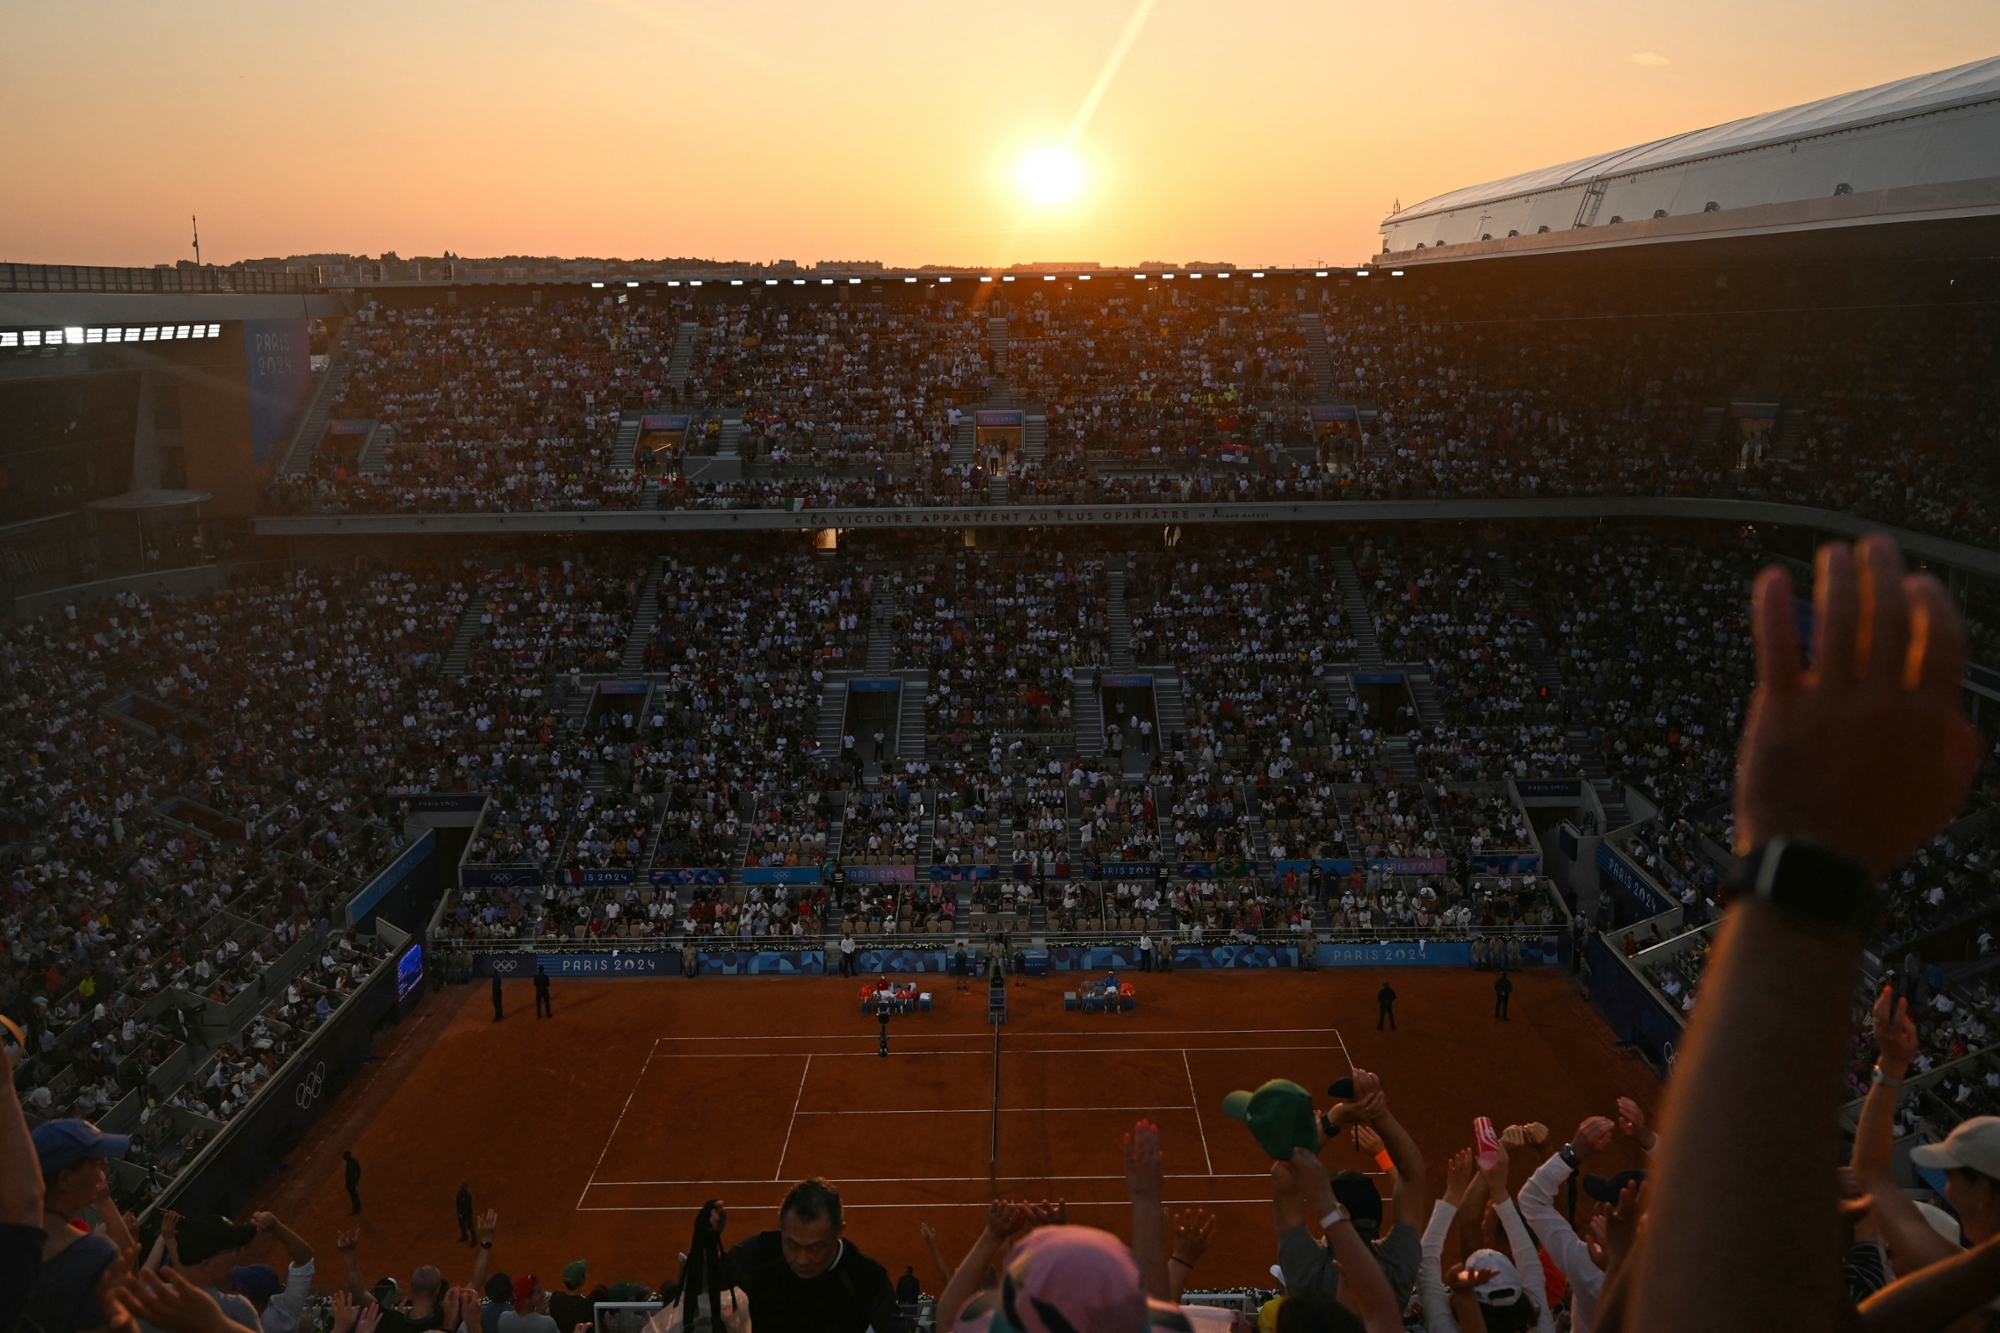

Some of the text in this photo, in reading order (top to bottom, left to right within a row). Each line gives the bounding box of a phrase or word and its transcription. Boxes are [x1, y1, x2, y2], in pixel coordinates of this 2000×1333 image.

[258, 355, 292, 376] 2024
[811, 515, 828, 524] LA
[836, 515, 912, 524] VICTOIRE
[921, 513, 1020, 523] APPARTIENT
[1028, 513, 1048, 521] AU
[1057, 512, 1094, 521] PLUS
[1411, 862, 1440, 870] 2024
[597, 873, 627, 881] 2024
[880, 870, 909, 878] 2024
[1633, 881, 1657, 913] 2024
[1385, 949, 1426, 960] 2024
[614, 959, 655, 970] 2024
